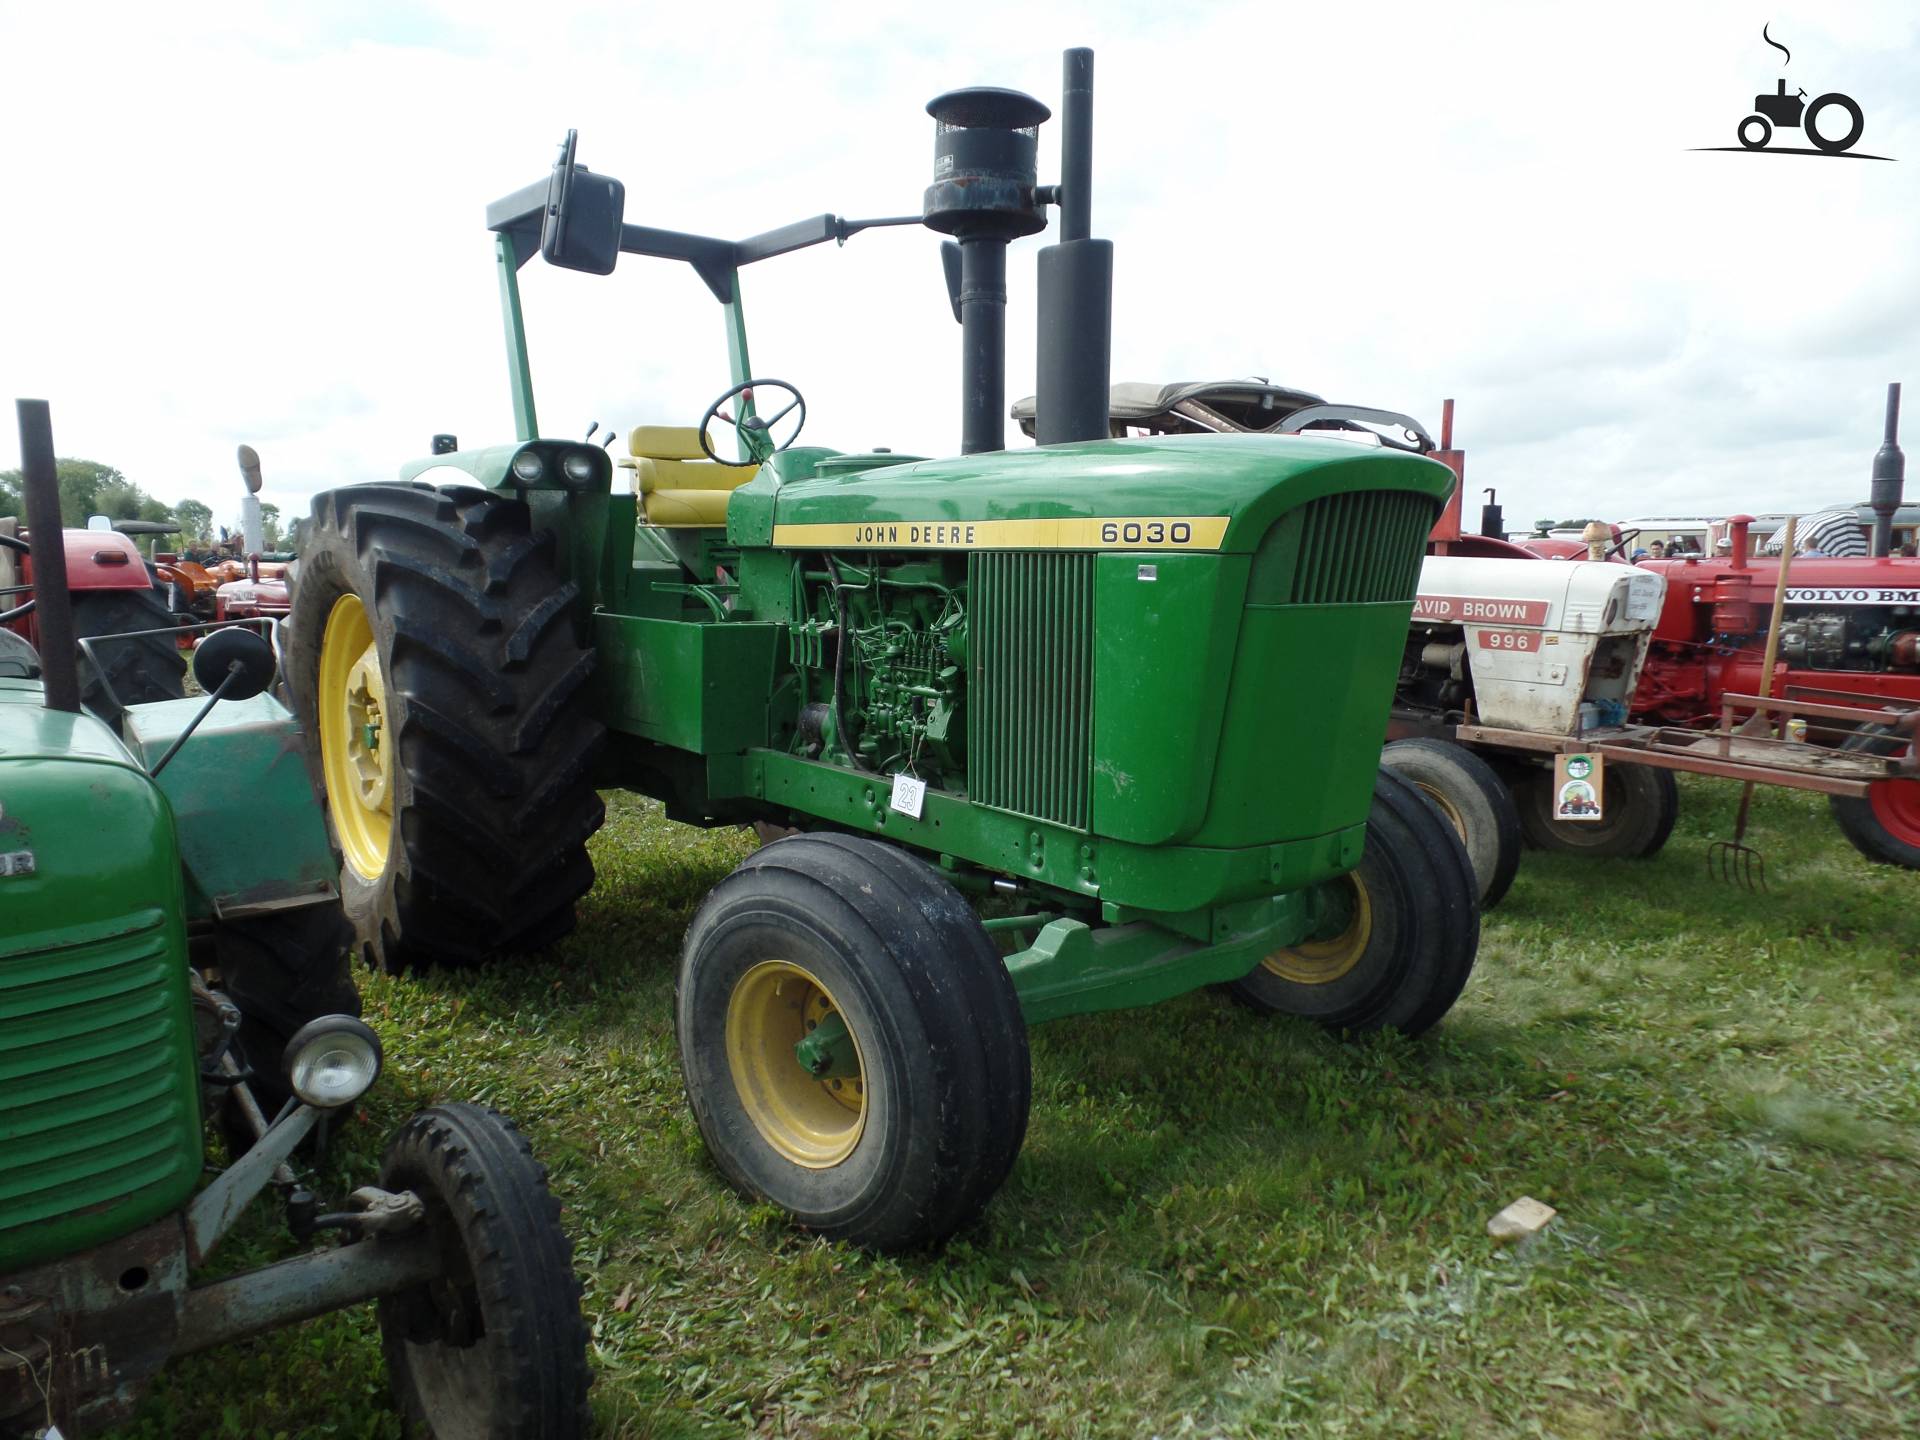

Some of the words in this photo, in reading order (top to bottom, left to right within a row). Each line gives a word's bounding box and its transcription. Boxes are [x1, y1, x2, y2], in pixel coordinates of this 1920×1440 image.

[855, 526, 897, 543] JOHN
[910, 526, 975, 544] DEERE
[1101, 522, 1191, 544] 6030
[1784, 590, 1869, 601] VOLVO
[1876, 590, 1920, 602] BM
[1412, 600, 1451, 614] AVID
[1462, 602, 1527, 619] BROWN
[1490, 633, 1528, 649] 996
[897, 782, 917, 812] 23
